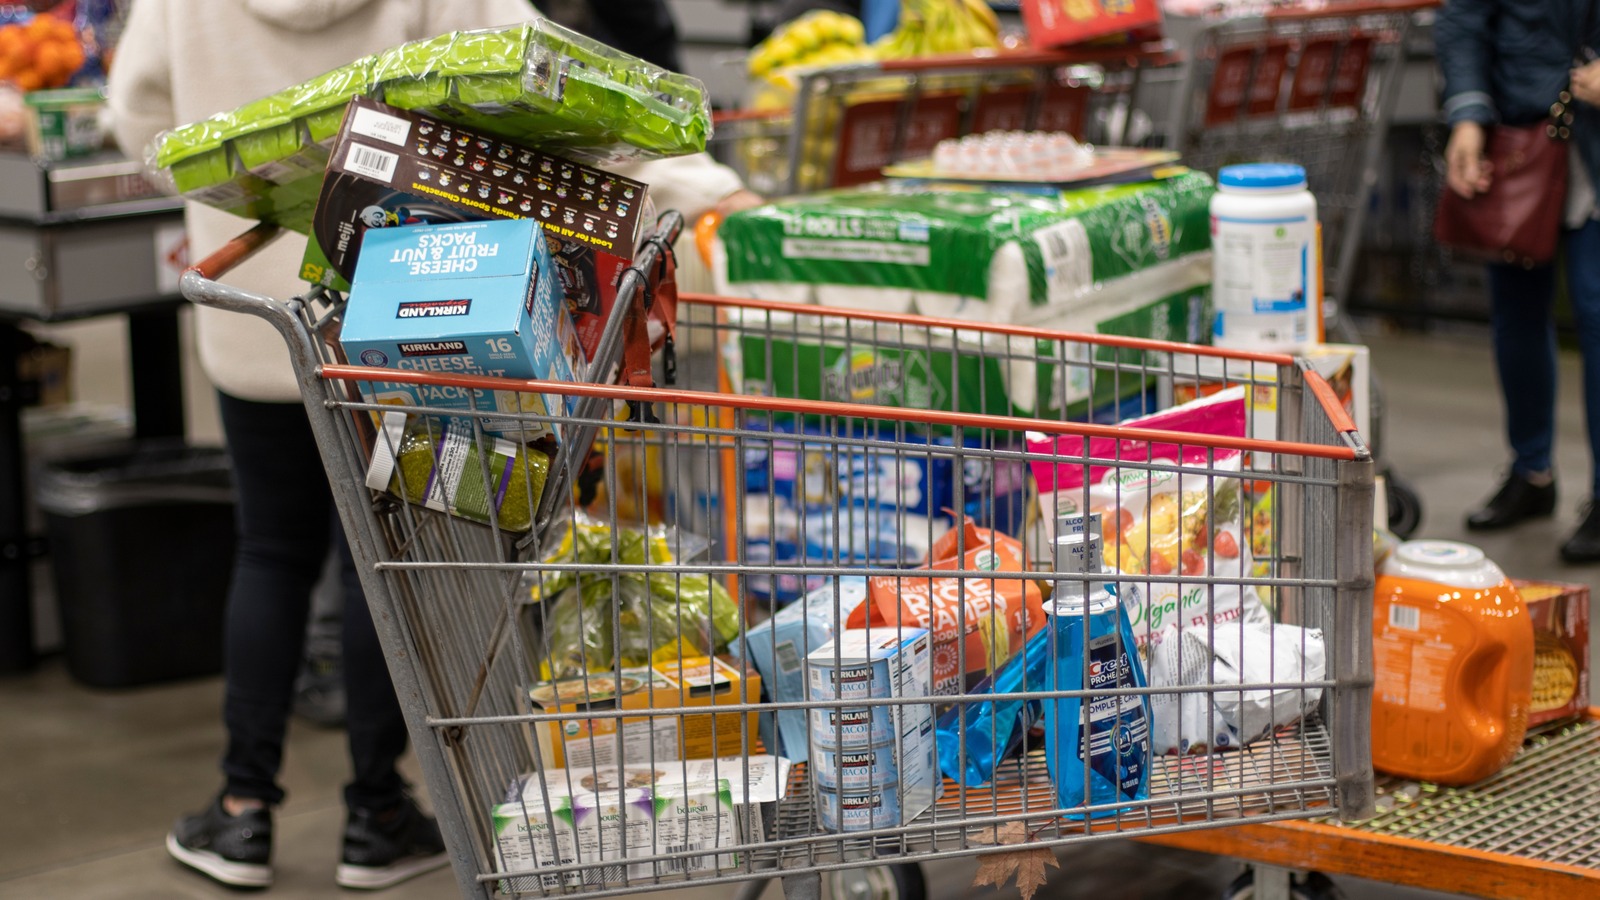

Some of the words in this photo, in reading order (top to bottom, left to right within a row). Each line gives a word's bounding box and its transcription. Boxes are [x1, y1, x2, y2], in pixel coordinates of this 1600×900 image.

[412, 182, 460, 203] Characters
[461, 196, 491, 212] Sports
[492, 207, 520, 221] Panda
[545, 223, 560, 233] the
[561, 227, 575, 237] All
[337, 221, 355, 252] meiji
[418, 231, 477, 248] PACKS
[574, 232, 590, 243] for
[591, 237, 613, 249] Look
[390, 248, 427, 263] NUT
[431, 247, 444, 260] &
[448, 243, 499, 259] FRUIT
[303, 263, 323, 282] 32
[408, 258, 478, 275] CHEESE,
[526, 260, 537, 310] KIRKLAND
[399, 305, 467, 317] KIRKLAND
[401, 342, 463, 352] KIRKLAND
[485, 338, 512, 353] 16
[397, 356, 482, 371] CHEESE,
[416, 385, 484, 400] PACKS
[1065, 516, 1097, 526] ALCOOL
[902, 578, 991, 616] RICE
[917, 594, 1008, 632] RAMEN
[1192, 606, 1244, 627] Bend
[933, 624, 973, 643] OODLS
[1089, 652, 1128, 677] Crest
[832, 669, 873, 679] RKLAN
[829, 681, 877, 692] ABACOE
[933, 675, 960, 691] OTUS
[933, 685, 960, 696] FOOD
[831, 712, 869, 721] KRKLAN
[829, 724, 877, 734] ABACOE
[842, 796, 880, 805] KIRKLAD
[541, 858, 574, 867] BOUSIN
